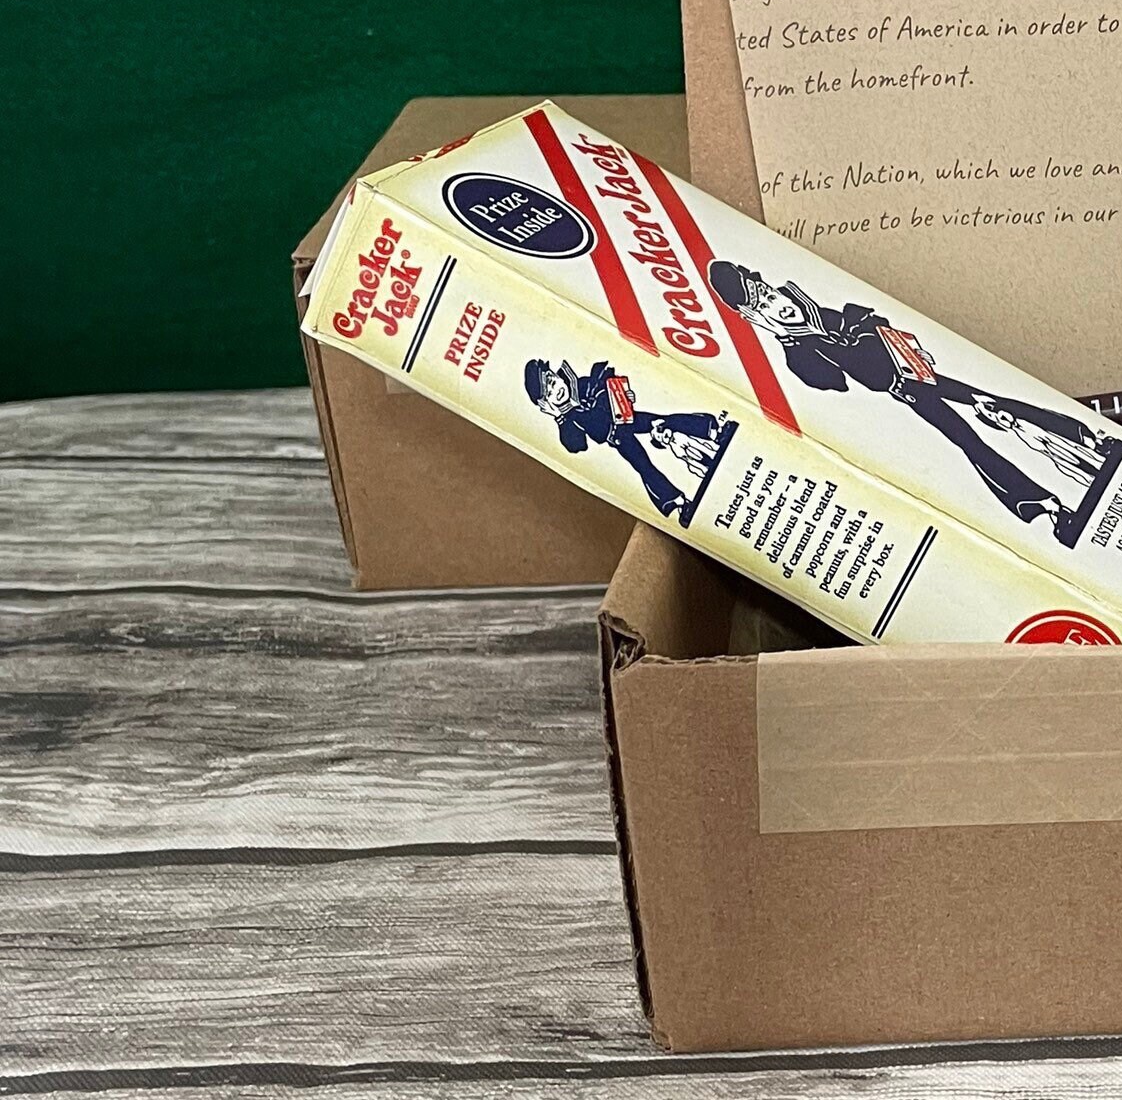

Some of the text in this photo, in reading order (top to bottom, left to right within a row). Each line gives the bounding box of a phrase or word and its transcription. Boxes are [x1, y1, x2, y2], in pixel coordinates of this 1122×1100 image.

[782, 21, 859, 49] States
[868, 16, 891, 43] of
[896, 16, 989, 41] America
[997, 18, 1017, 36] in
[1027, 13, 1088, 36] order
[1098, 14, 1119, 33] to
[805, 71, 842, 95] the
[851, 64, 974, 91] homefront.
[470, 188, 530, 223] Prize
[761, 171, 784, 198] of
[790, 169, 834, 193] this
[843, 161, 924, 190] Nation,
[936, 159, 1000, 180] which
[1010, 165, 1036, 179] we
[1044, 157, 1083, 179] love
[498, 204, 563, 244] Inside
[813, 218, 871, 245] prove
[880, 211, 901, 230] to
[910, 206, 935, 227] be
[942, 206, 1046, 228] victorious
[1054, 206, 1074, 224] in
[1083, 208, 1119, 223] our
[333, 218, 402, 339] Cracker
[444, 302, 483, 366] PRIZE
[463, 309, 506, 382] INSIDE
[714, 455, 764, 530] Tastes just as
[738, 470, 779, 540] good as you
[753, 491, 786, 552] remember
[788, 474, 798, 484] a
[768, 477, 817, 565] delicious blend
[782, 480, 838, 580] of caramel coated
[805, 504, 847, 579] popcorn and
[819, 510, 868, 594] peanuts, with a
[833, 521, 884, 600] fun surprise in
[1091, 512, 1119, 548] TASTES
[859, 543, 894, 599] every box.
